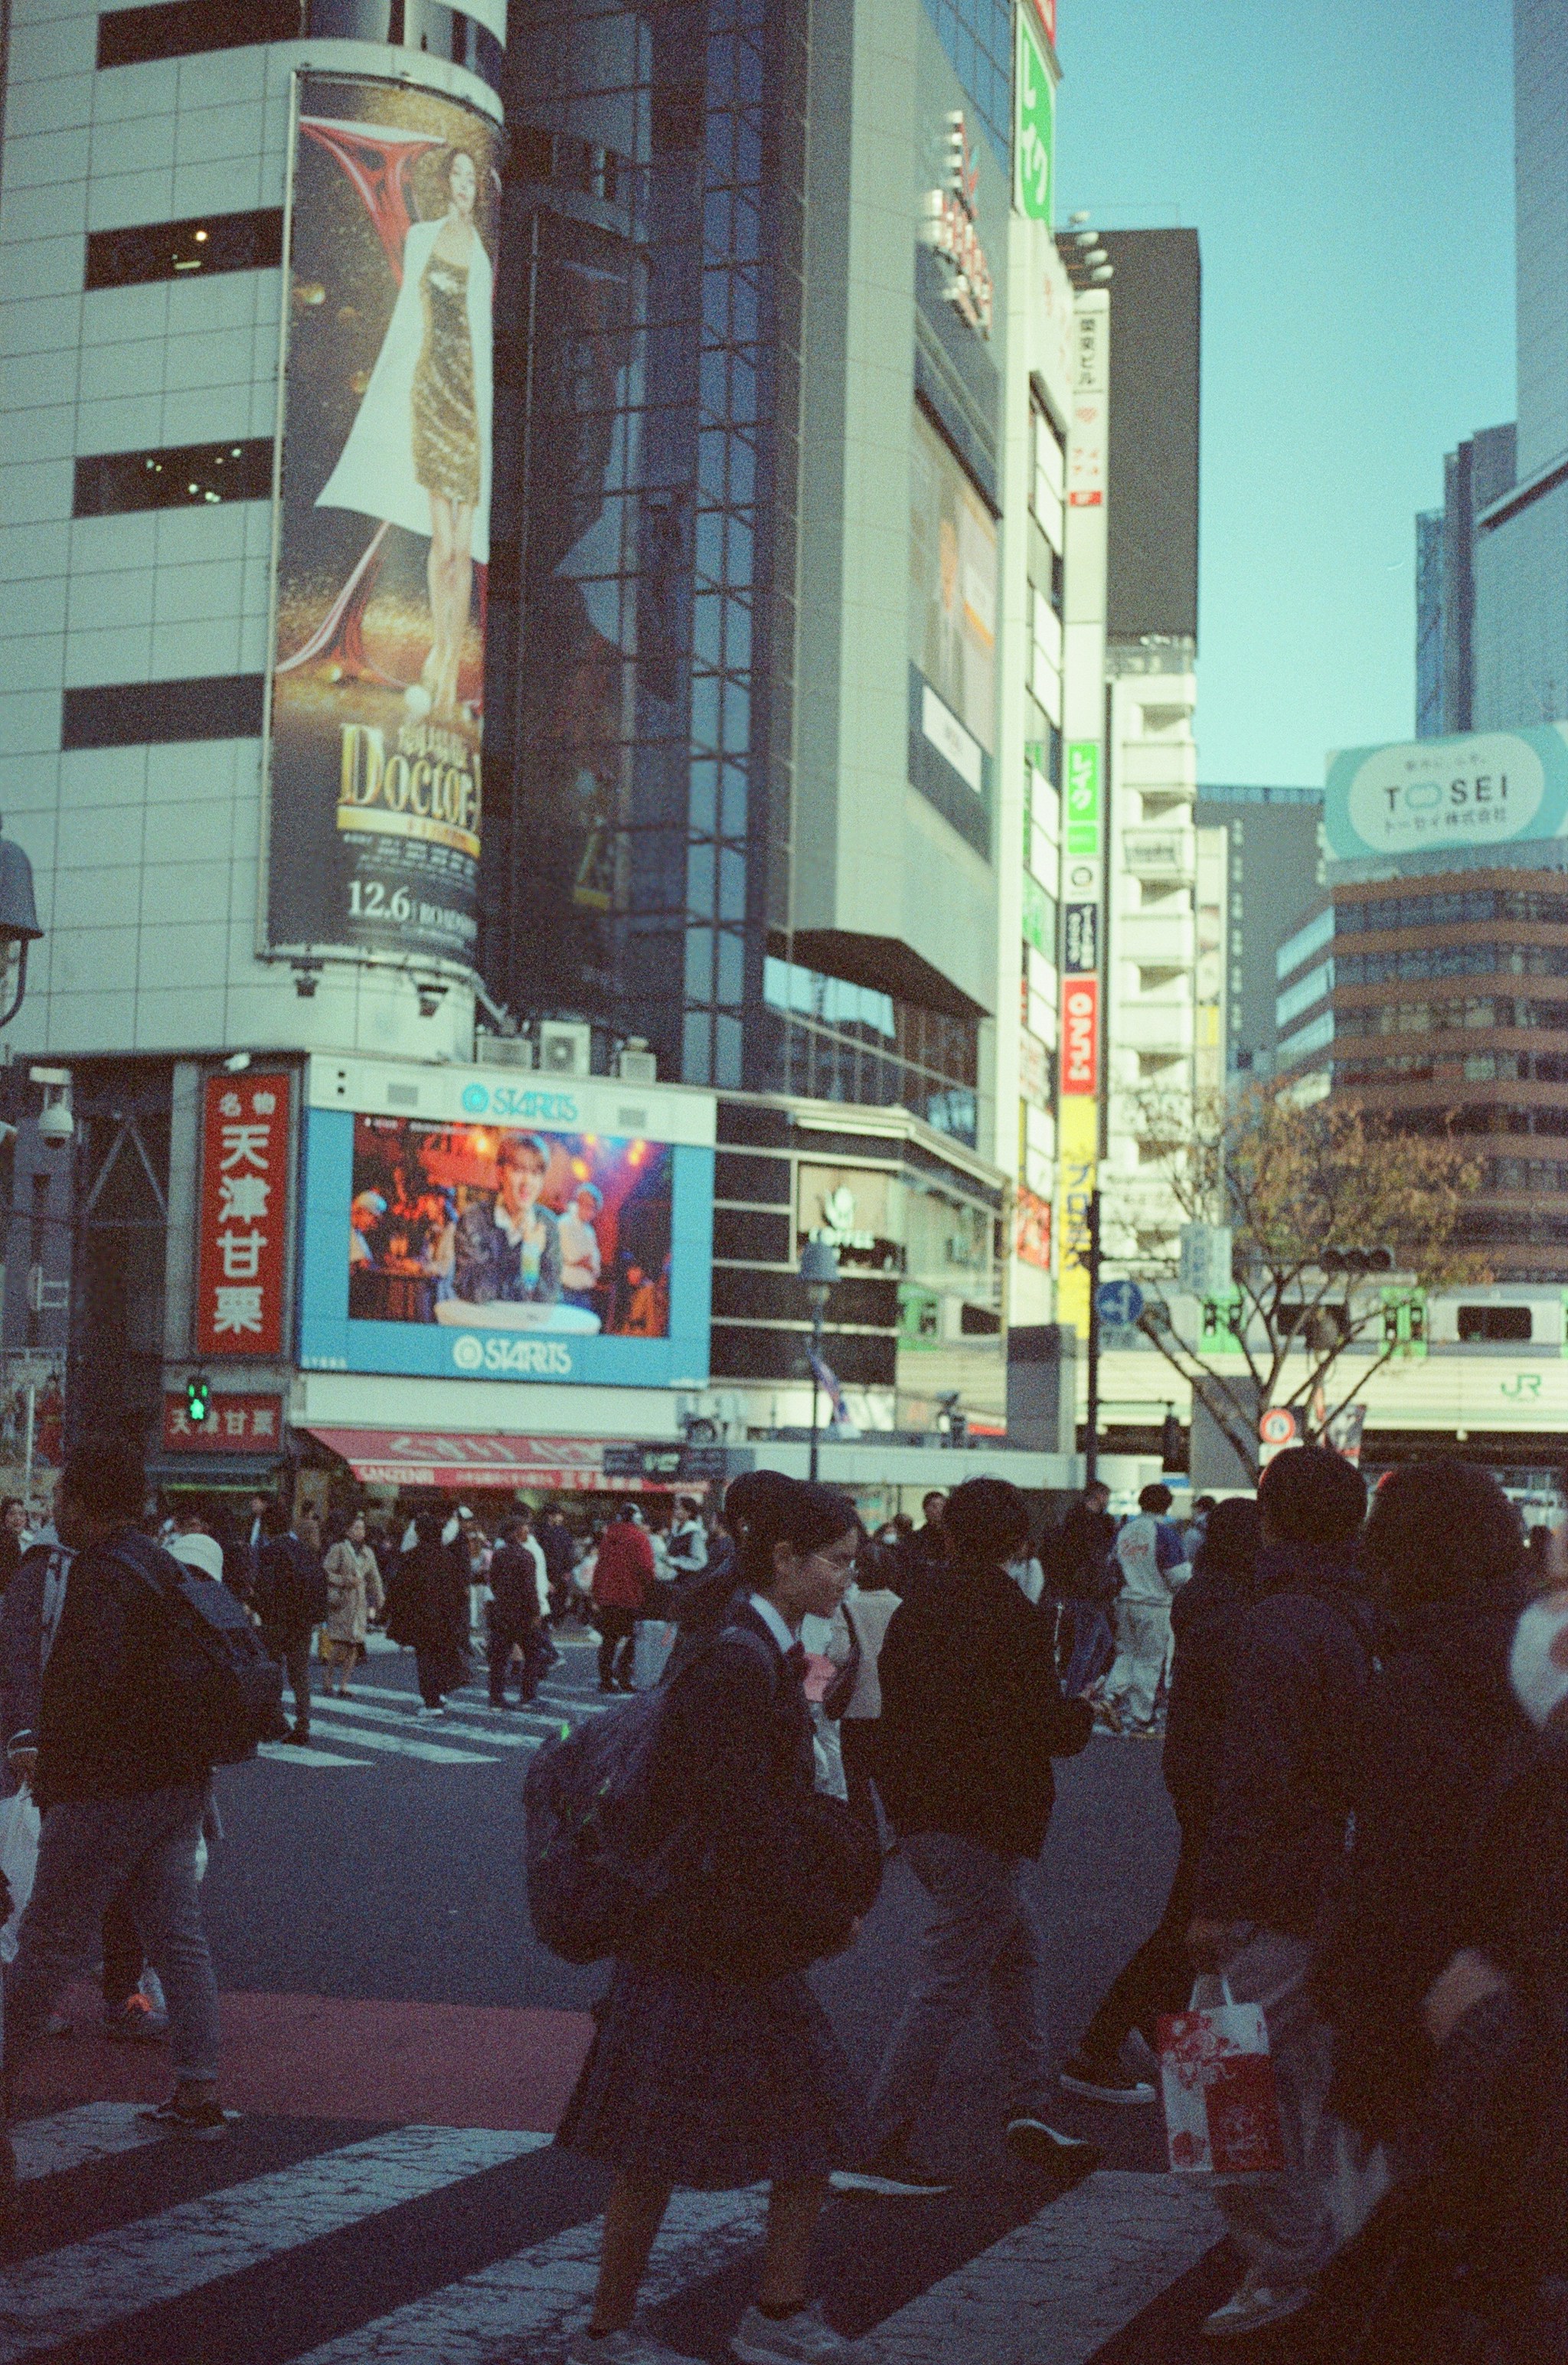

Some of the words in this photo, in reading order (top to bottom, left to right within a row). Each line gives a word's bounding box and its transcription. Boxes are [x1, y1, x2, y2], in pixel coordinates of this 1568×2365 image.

[1383, 773, 1508, 812] TOSEI
[347, 880, 410, 921] 12.6
[493, 1086, 578, 1122] STARTS
[213, 1124, 272, 1334] 天津甘栗
[485, 1338, 572, 1374] STARTS
[1501, 1374, 1542, 1396] JR
